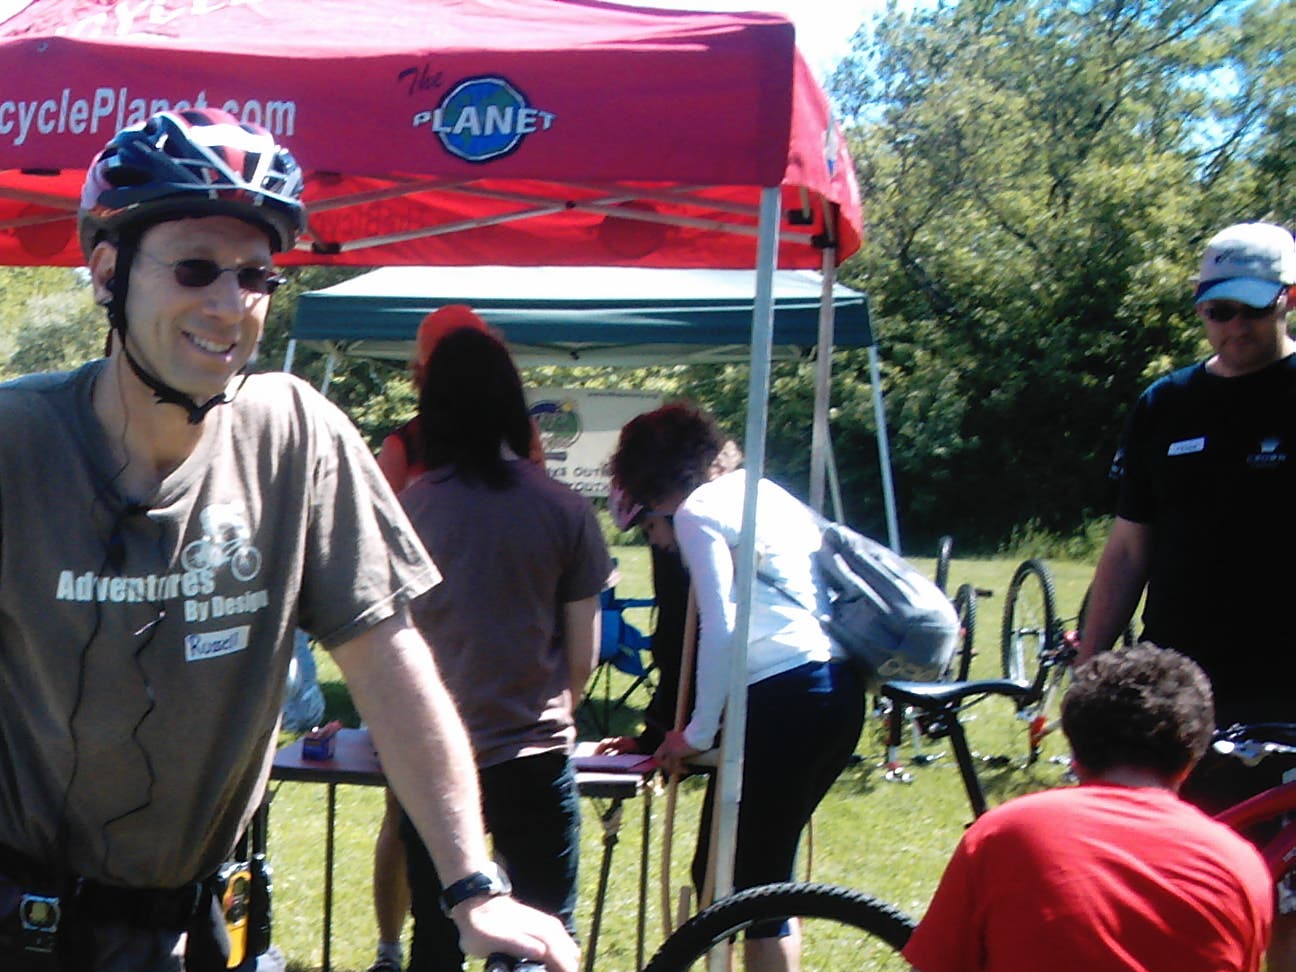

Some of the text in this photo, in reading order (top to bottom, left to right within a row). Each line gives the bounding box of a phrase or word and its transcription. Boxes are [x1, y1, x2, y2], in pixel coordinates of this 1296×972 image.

[412, 105, 557, 137] PLANET
[55, 569, 216, 602] Adventures
[184, 589, 270, 622] By Design
